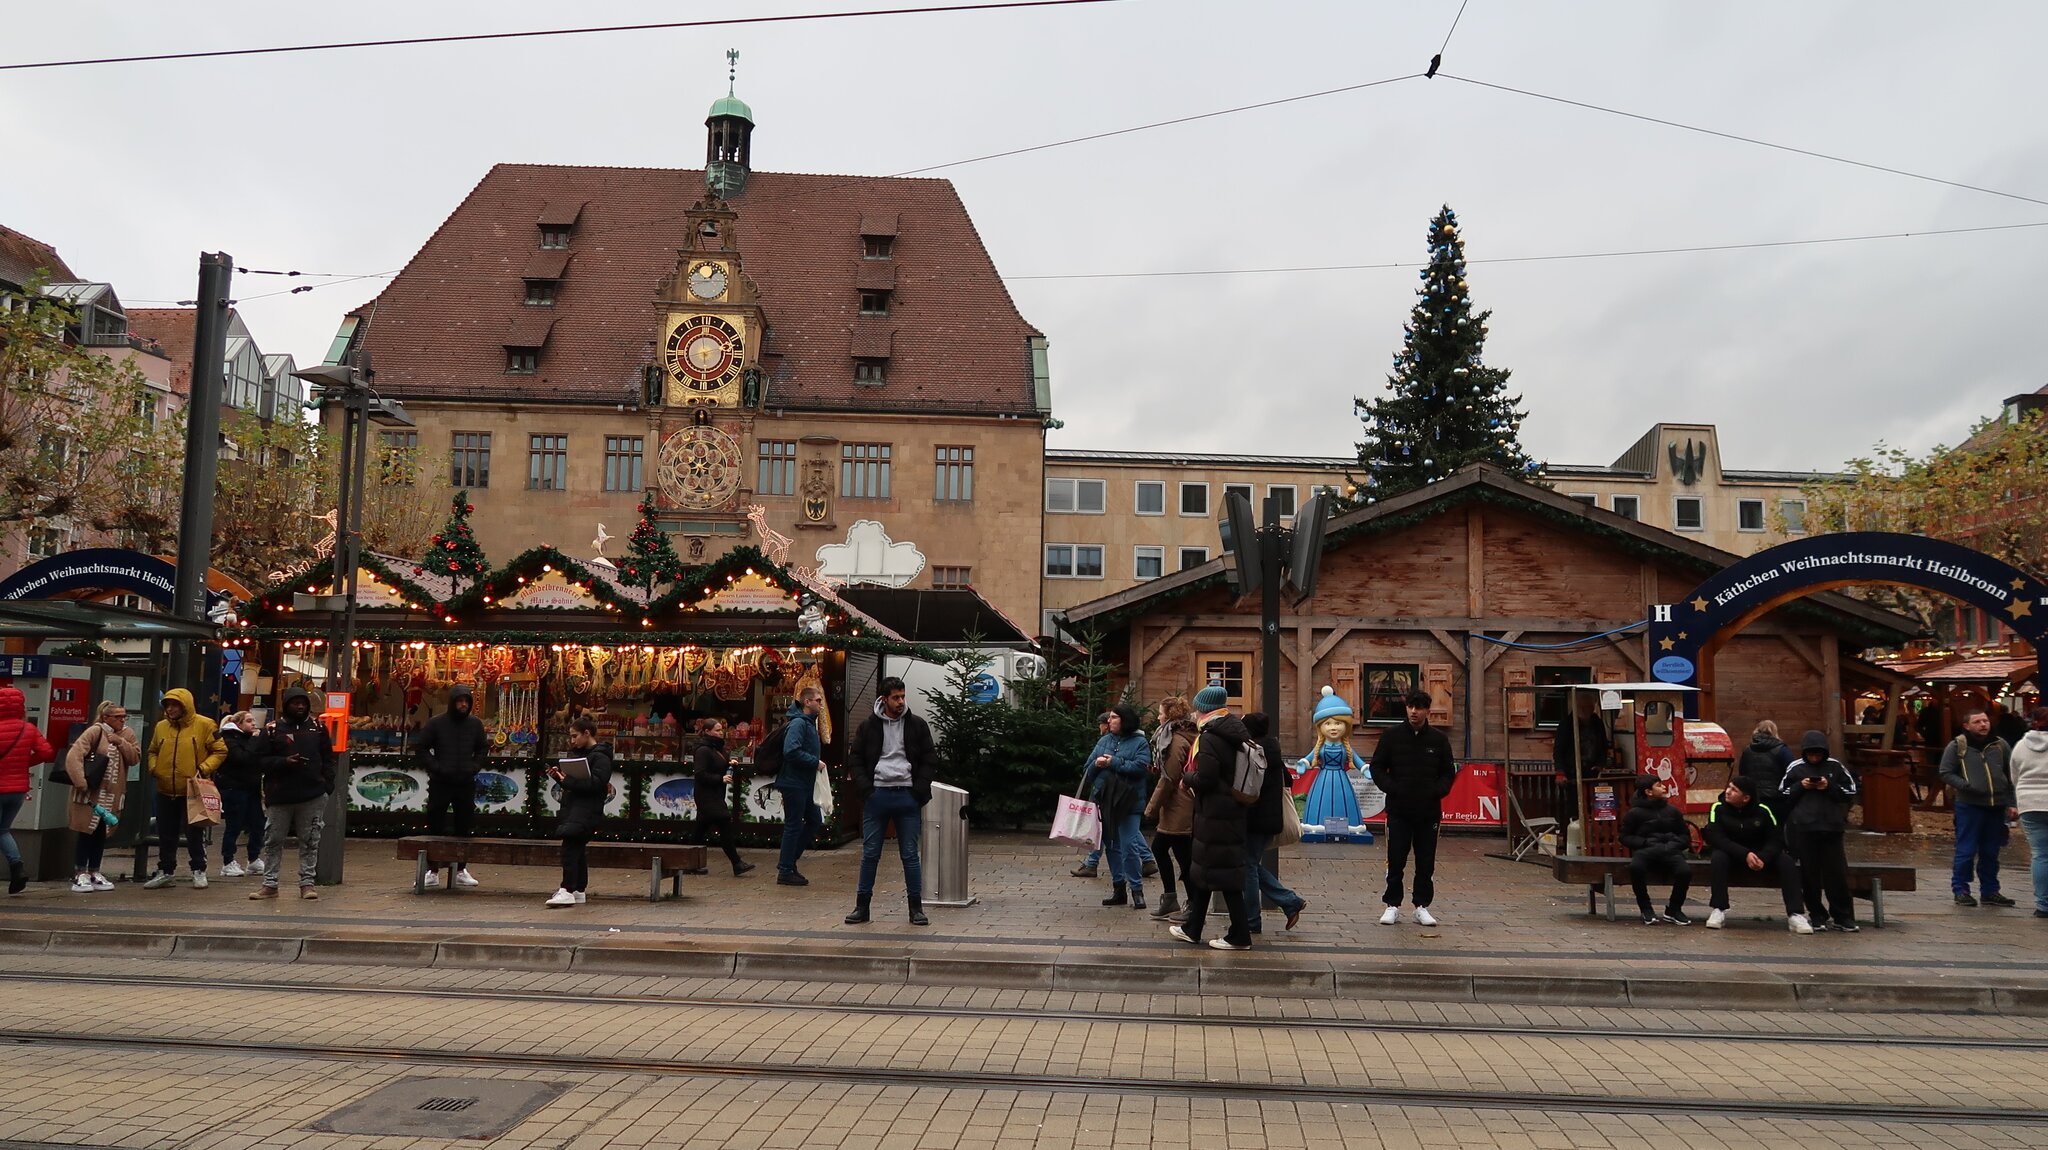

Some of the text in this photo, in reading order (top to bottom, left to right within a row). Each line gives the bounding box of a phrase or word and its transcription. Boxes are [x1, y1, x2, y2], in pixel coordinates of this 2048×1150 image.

[3, 563, 176, 600] äthchen Weihnachtsmarkt Heilbr
[1714, 551, 2008, 606] Käthchen Weihnachtsmarkt Heilbronn
[1654, 604, 1672, 622] H
[50, 706, 82, 715] Fahrkarten
